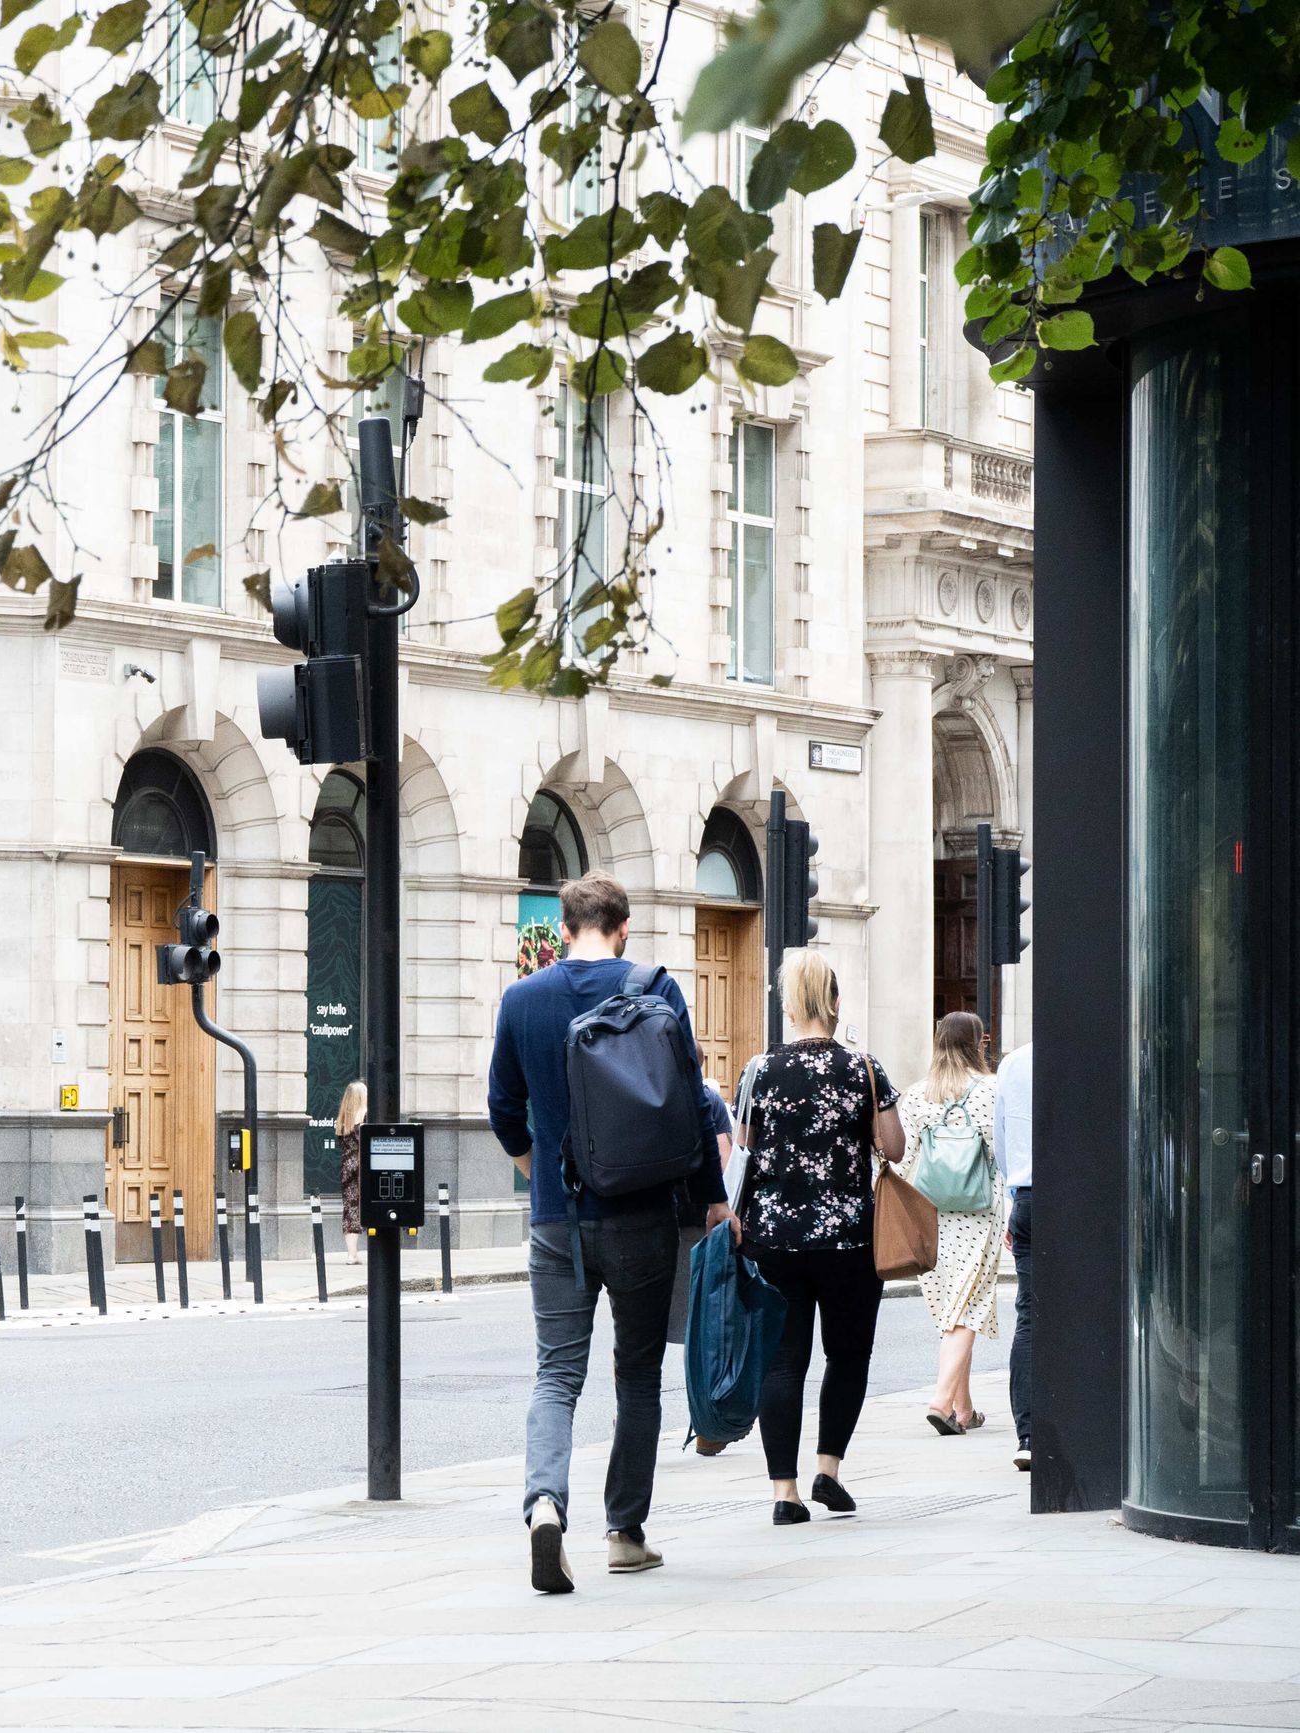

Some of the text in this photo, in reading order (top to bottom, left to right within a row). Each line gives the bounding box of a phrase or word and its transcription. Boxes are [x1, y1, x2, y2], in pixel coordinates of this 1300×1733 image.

[316, 1003, 347, 1018] say hello
[318, 1116, 334, 1127] salad
